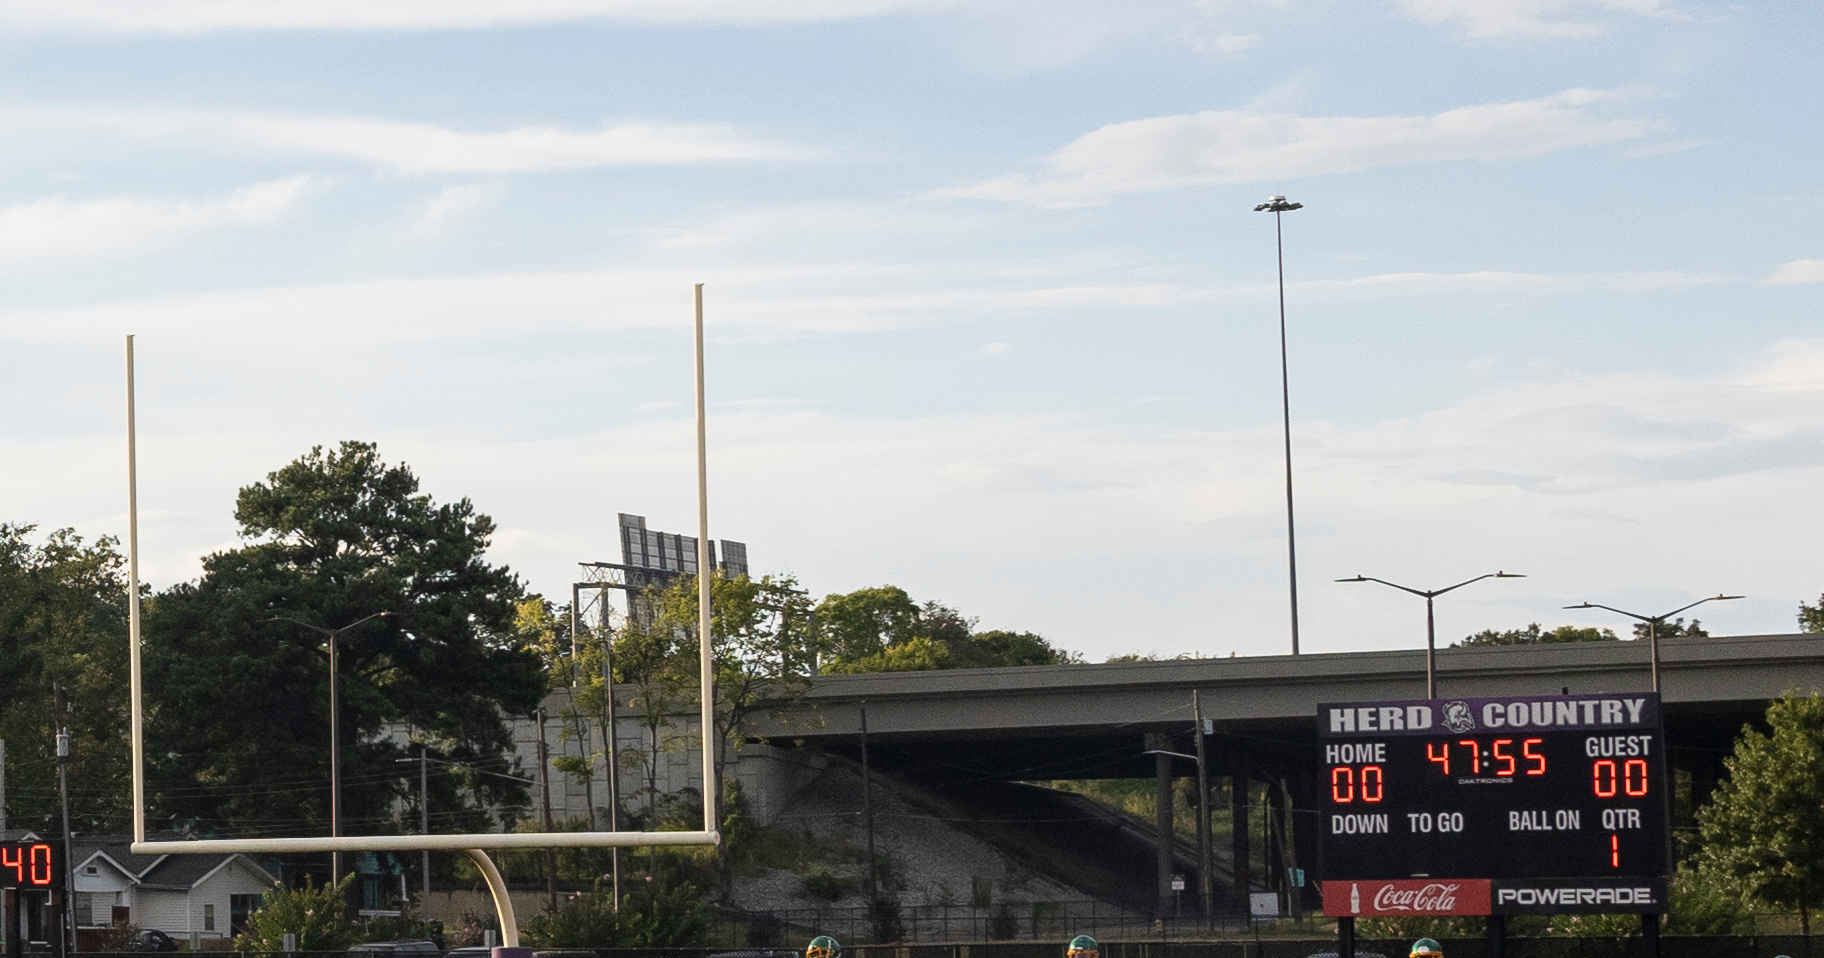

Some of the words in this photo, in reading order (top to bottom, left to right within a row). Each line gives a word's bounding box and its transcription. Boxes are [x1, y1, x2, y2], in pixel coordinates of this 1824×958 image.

[1329, 704, 1433, 733] HERD
[1482, 698, 1646, 728] COUNTRY
[1326, 743, 1386, 764] HOME
[1426, 737, 1546, 776] 47:55
[1585, 735, 1652, 757] GUEST
[1331, 765, 1383, 803] 00
[1592, 759, 1648, 798] 00
[1332, 814, 1389, 835] DOWN
[1407, 812, 1432, 833] TO
[1437, 811, 1464, 833] GO
[1509, 810, 1553, 831] BALL
[1555, 809, 1581, 831] ON
[1602, 808, 1641, 830] QTR
[2, 844, 51, 885] 40
[1373, 883, 1461, 912] Coca-Cola
[1498, 887, 1651, 905] POWERADE
